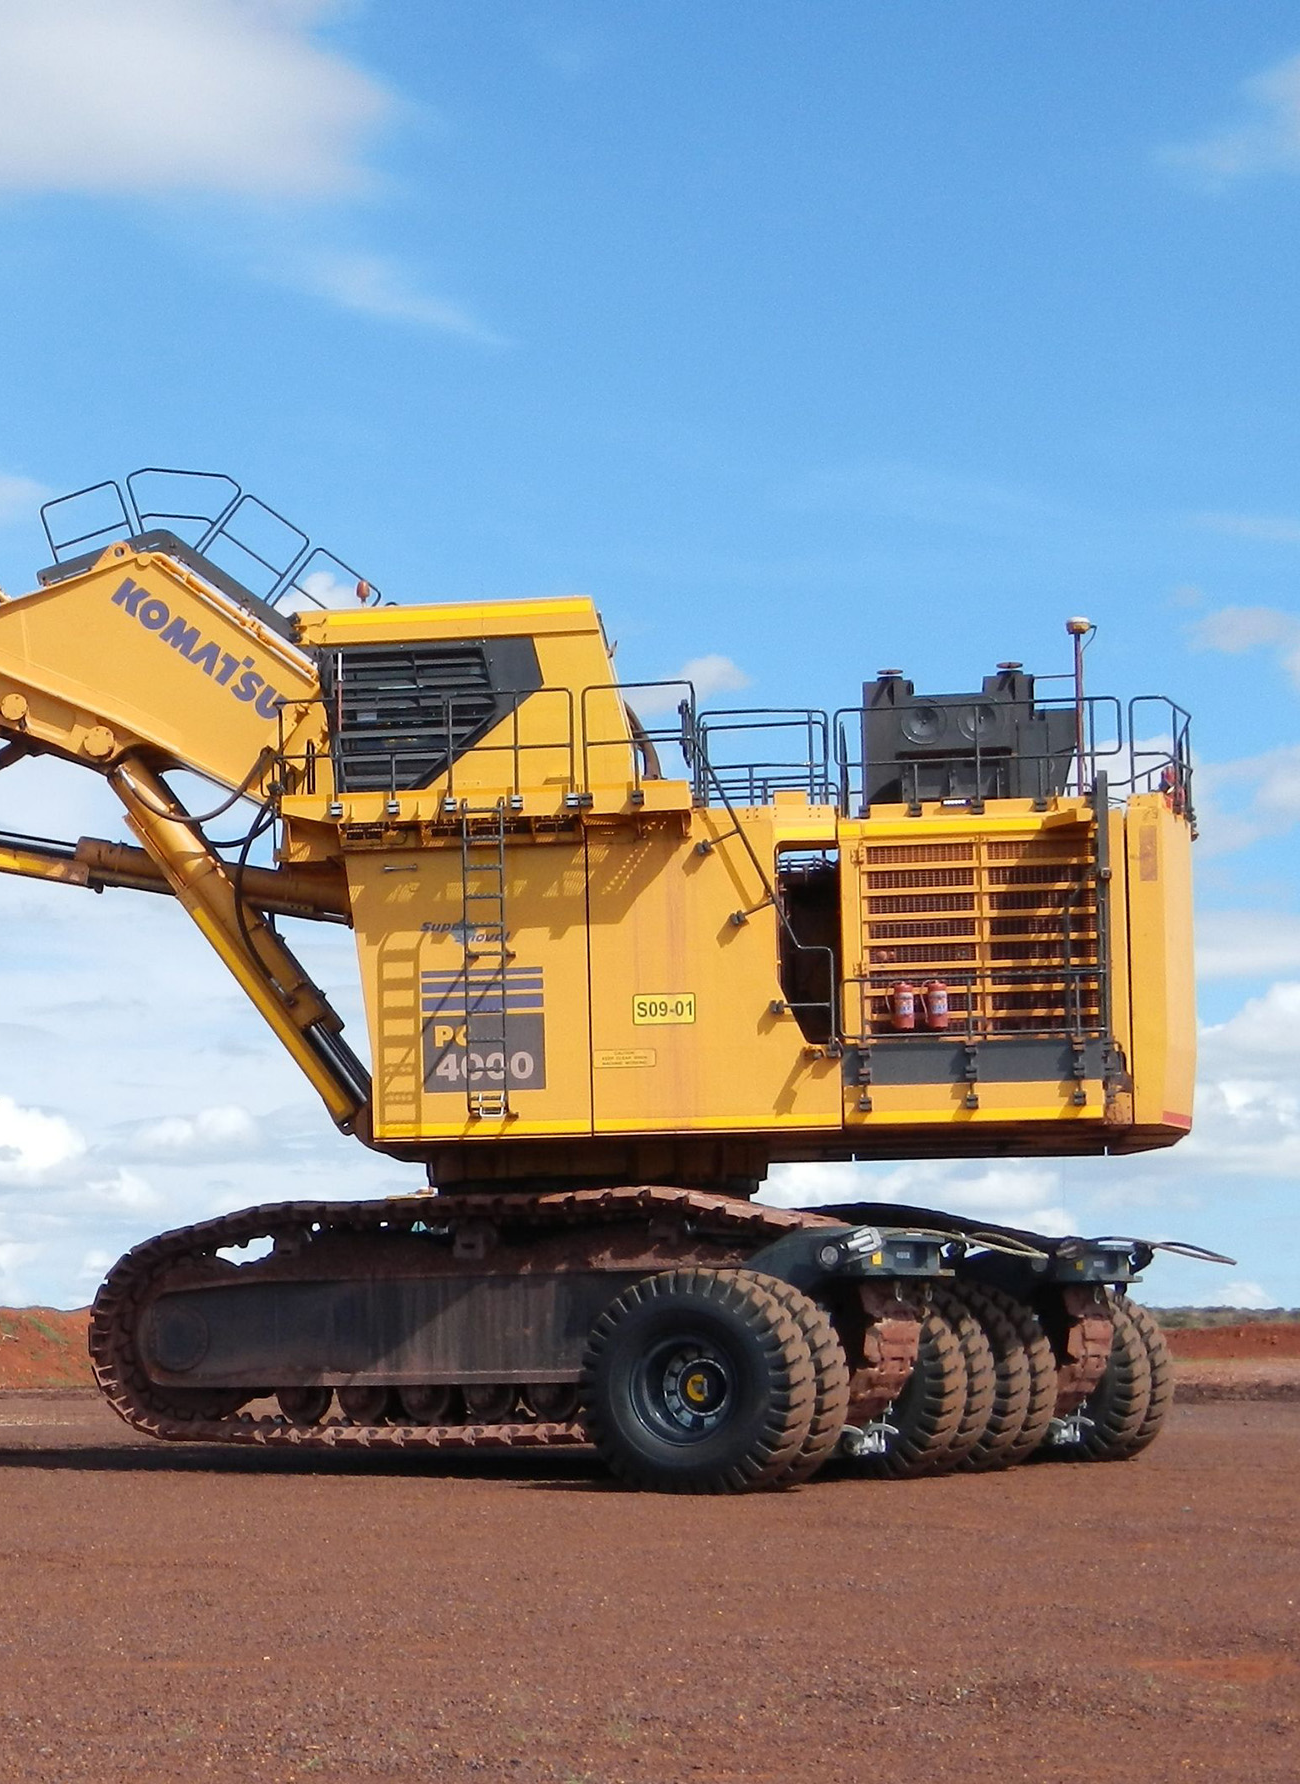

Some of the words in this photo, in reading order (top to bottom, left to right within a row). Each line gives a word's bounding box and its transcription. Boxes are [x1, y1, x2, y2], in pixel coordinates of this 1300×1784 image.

[111, 577, 288, 719] KOMATSU
[637, 1001, 693, 1017] S09-01
[436, 1051, 534, 1082] 4000
